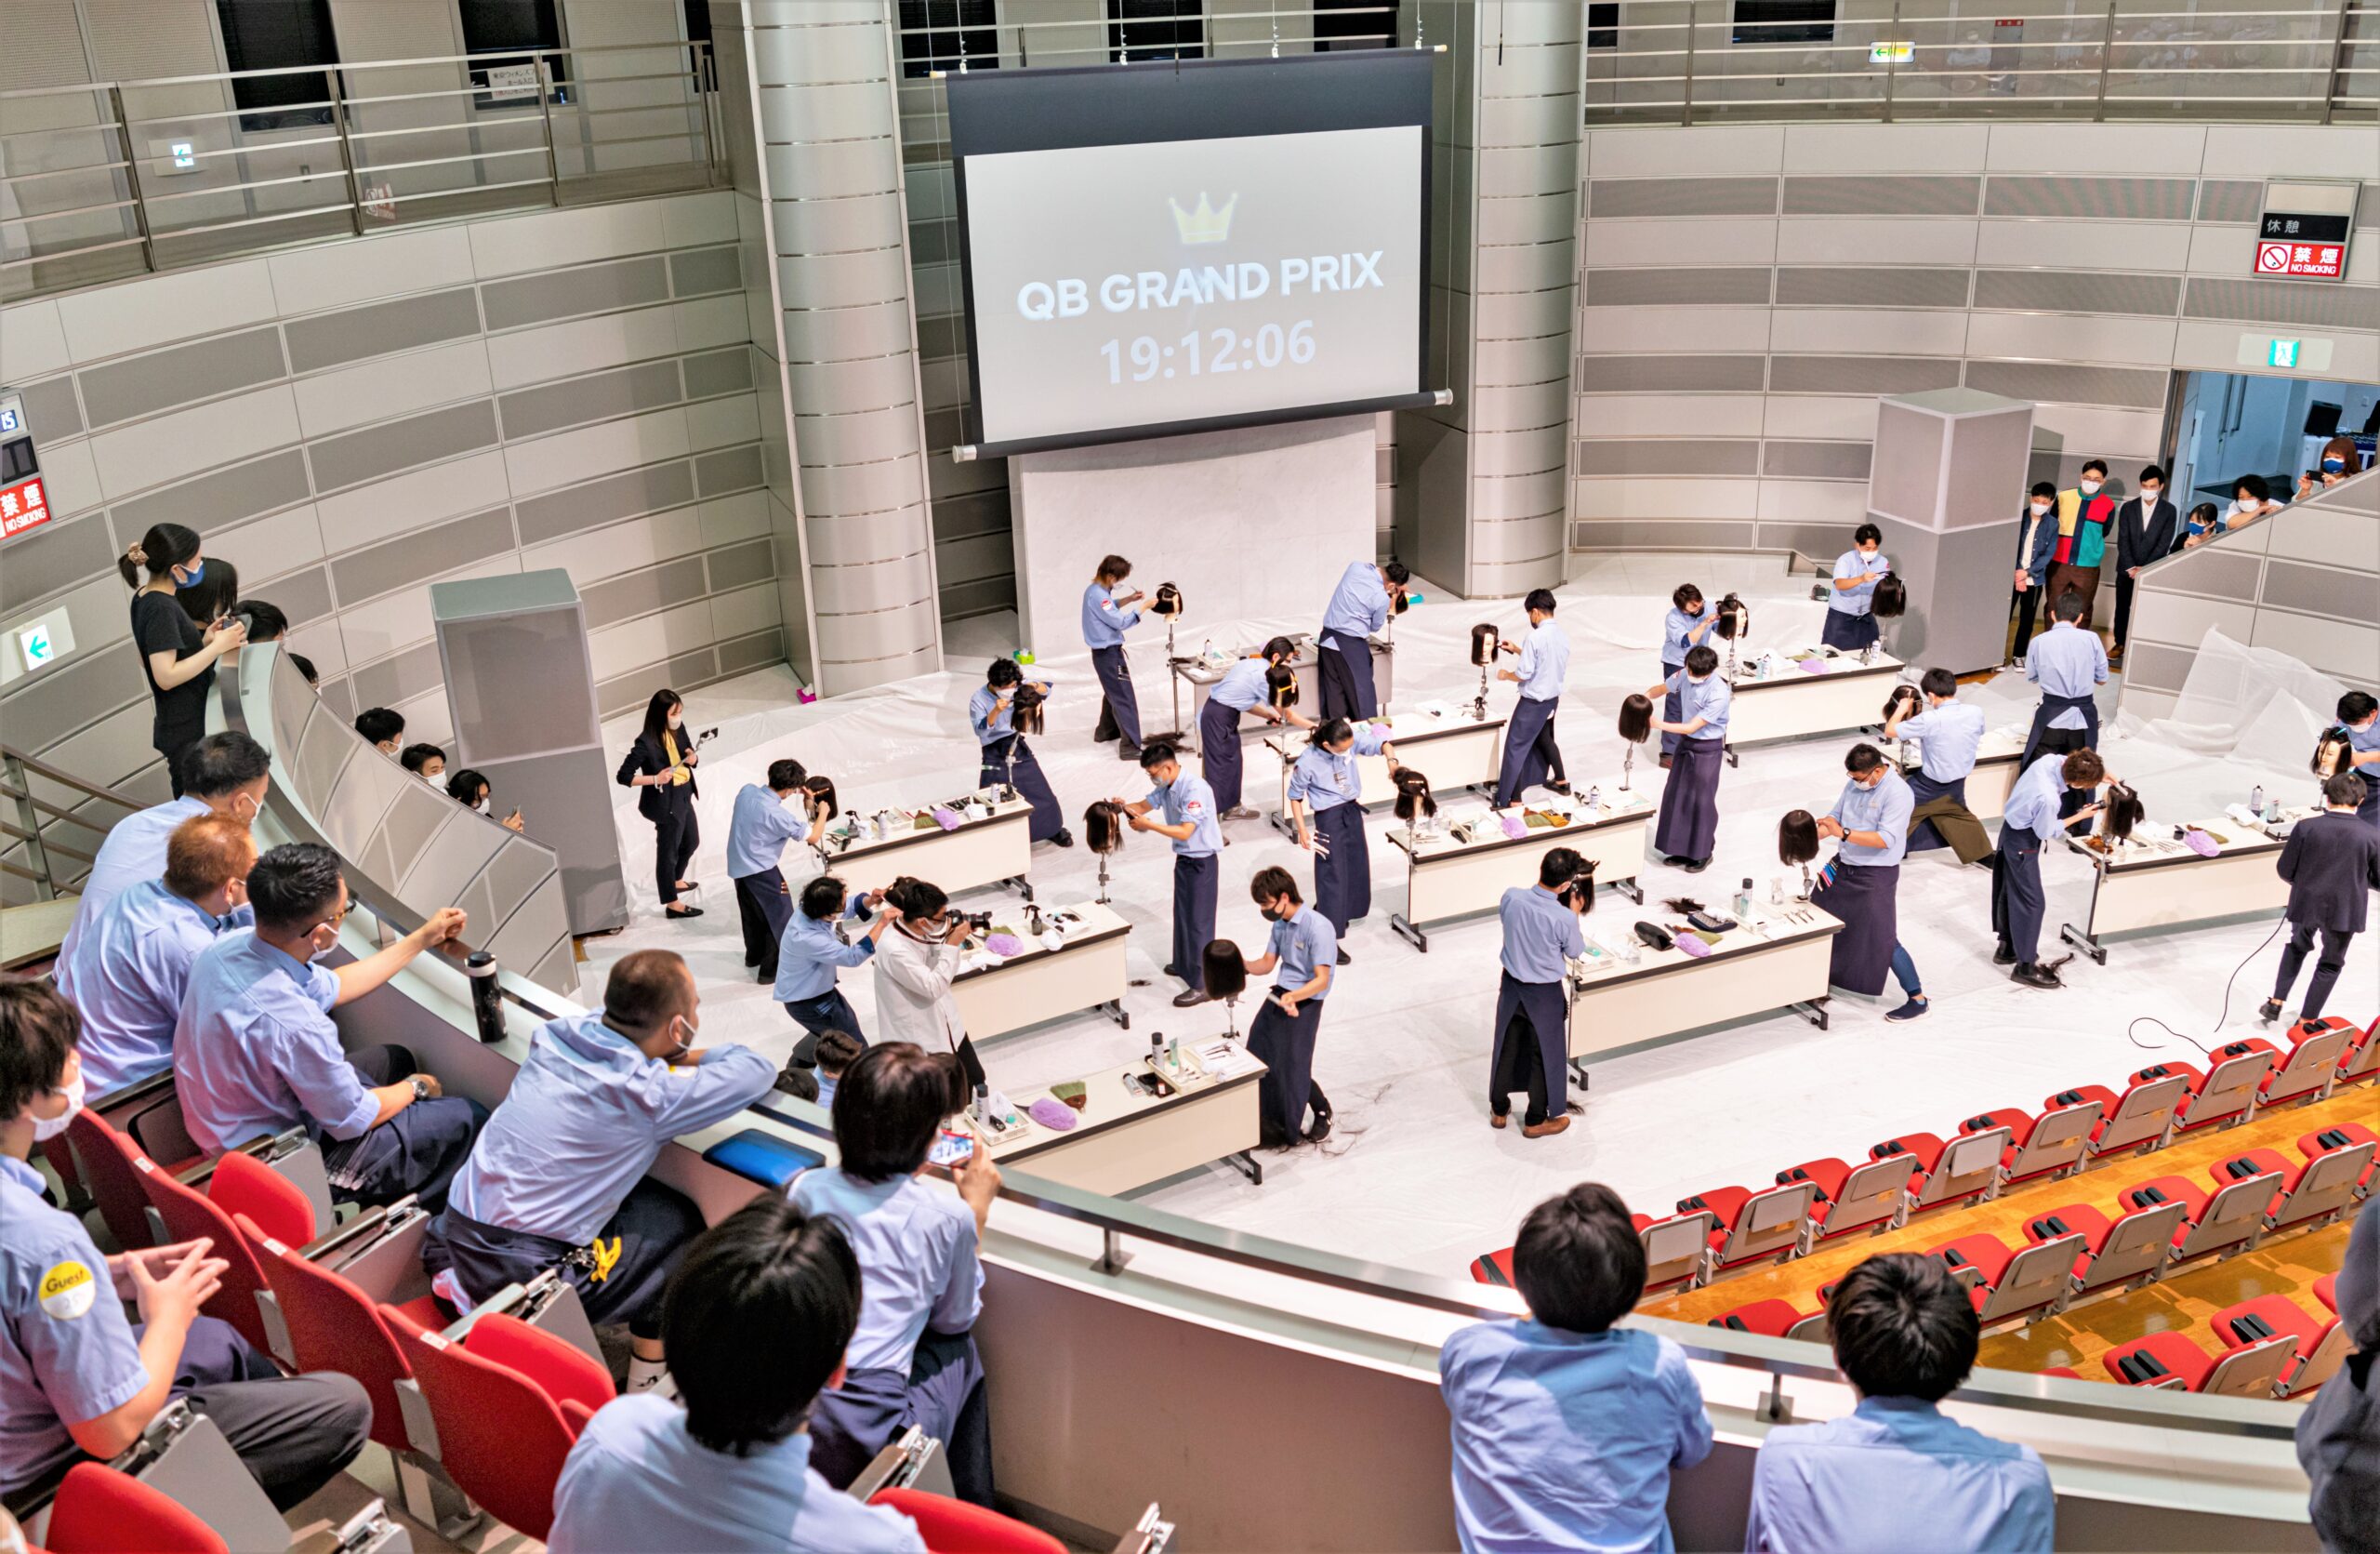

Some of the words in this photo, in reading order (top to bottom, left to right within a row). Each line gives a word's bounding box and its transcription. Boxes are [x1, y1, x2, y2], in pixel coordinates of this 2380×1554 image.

[2267, 219, 2300, 233] 休憩
[2294, 246, 2339, 264] 禁煙
[2291, 264, 2303, 272] NO
[2303, 264, 2336, 274] SMOKING
[1016, 279, 1089, 321] QB
[1099, 262, 1270, 312] GRAND
[1281, 250, 1384, 295] PRIX
[1100, 320, 1316, 384] 19:12:06
[1, 484, 43, 517] 禁煙
[6, 518, 17, 533] NO
[16, 508, 46, 528] SMOKING
[46, 1270, 84, 1293] Guest
